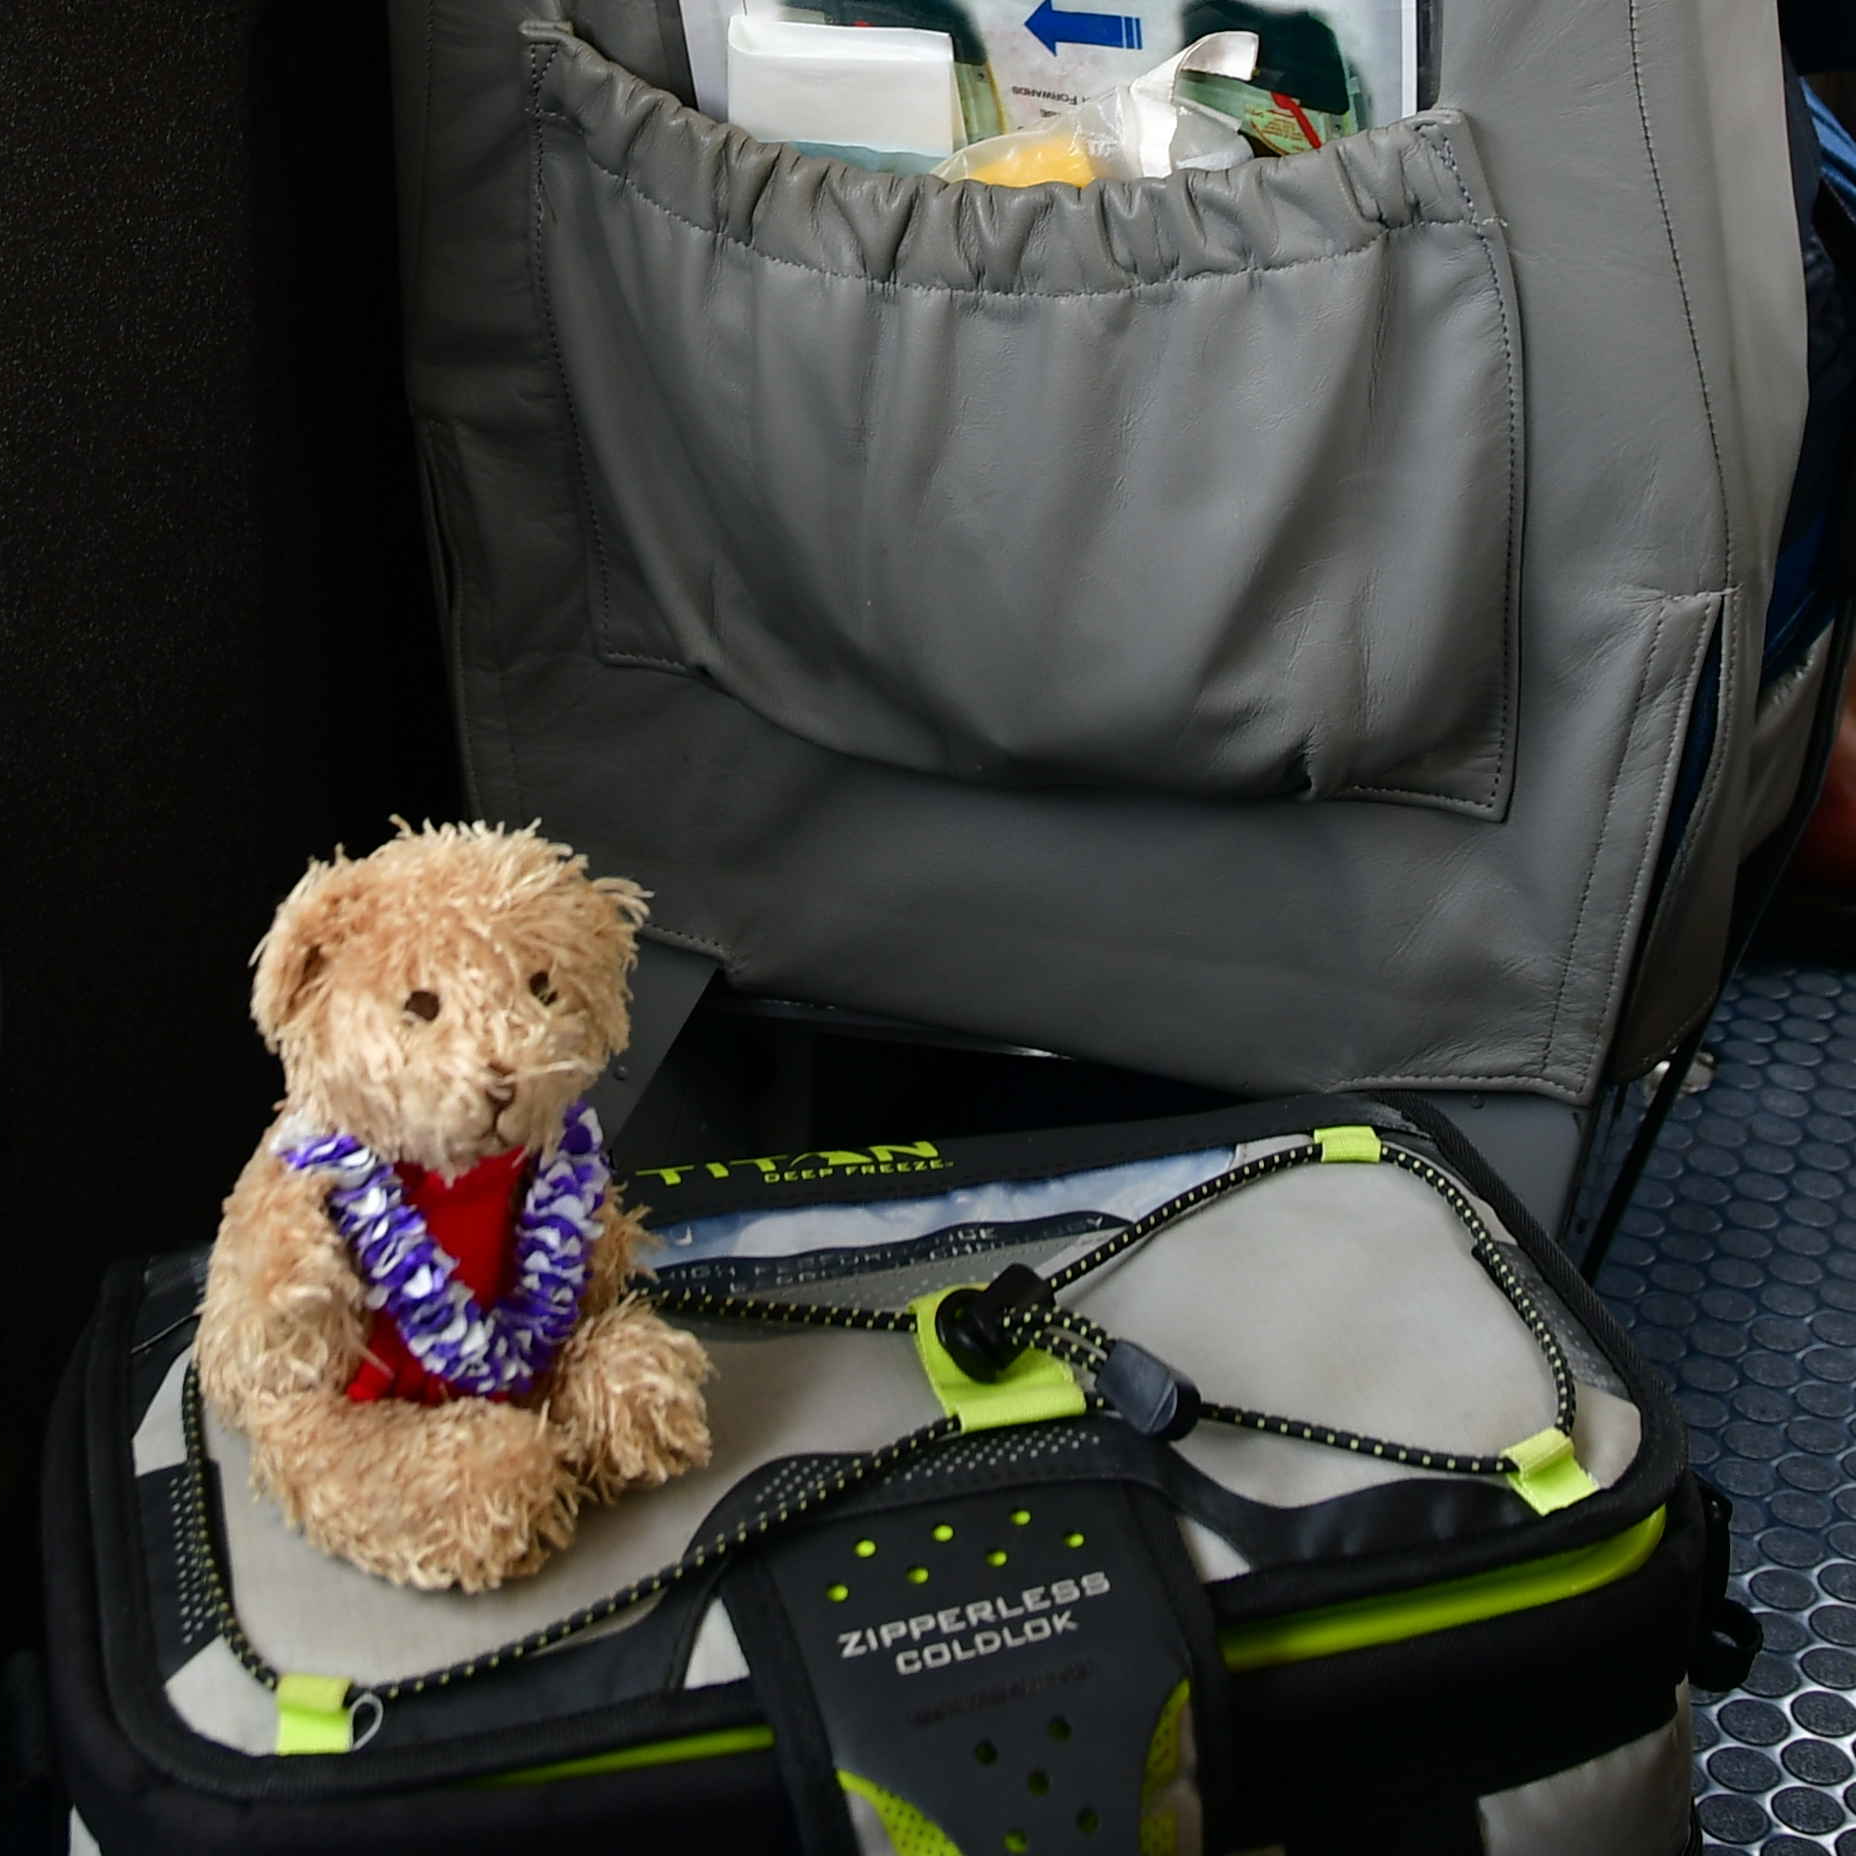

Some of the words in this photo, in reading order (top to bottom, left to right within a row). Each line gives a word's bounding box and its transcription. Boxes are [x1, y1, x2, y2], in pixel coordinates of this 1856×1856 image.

[635, 1141, 940, 1186] TITAN
[763, 1167, 834, 1184] DEEP
[838, 1571, 1111, 1659] ZIPPERLESS
[896, 1610, 1080, 1676] COLDLOK
